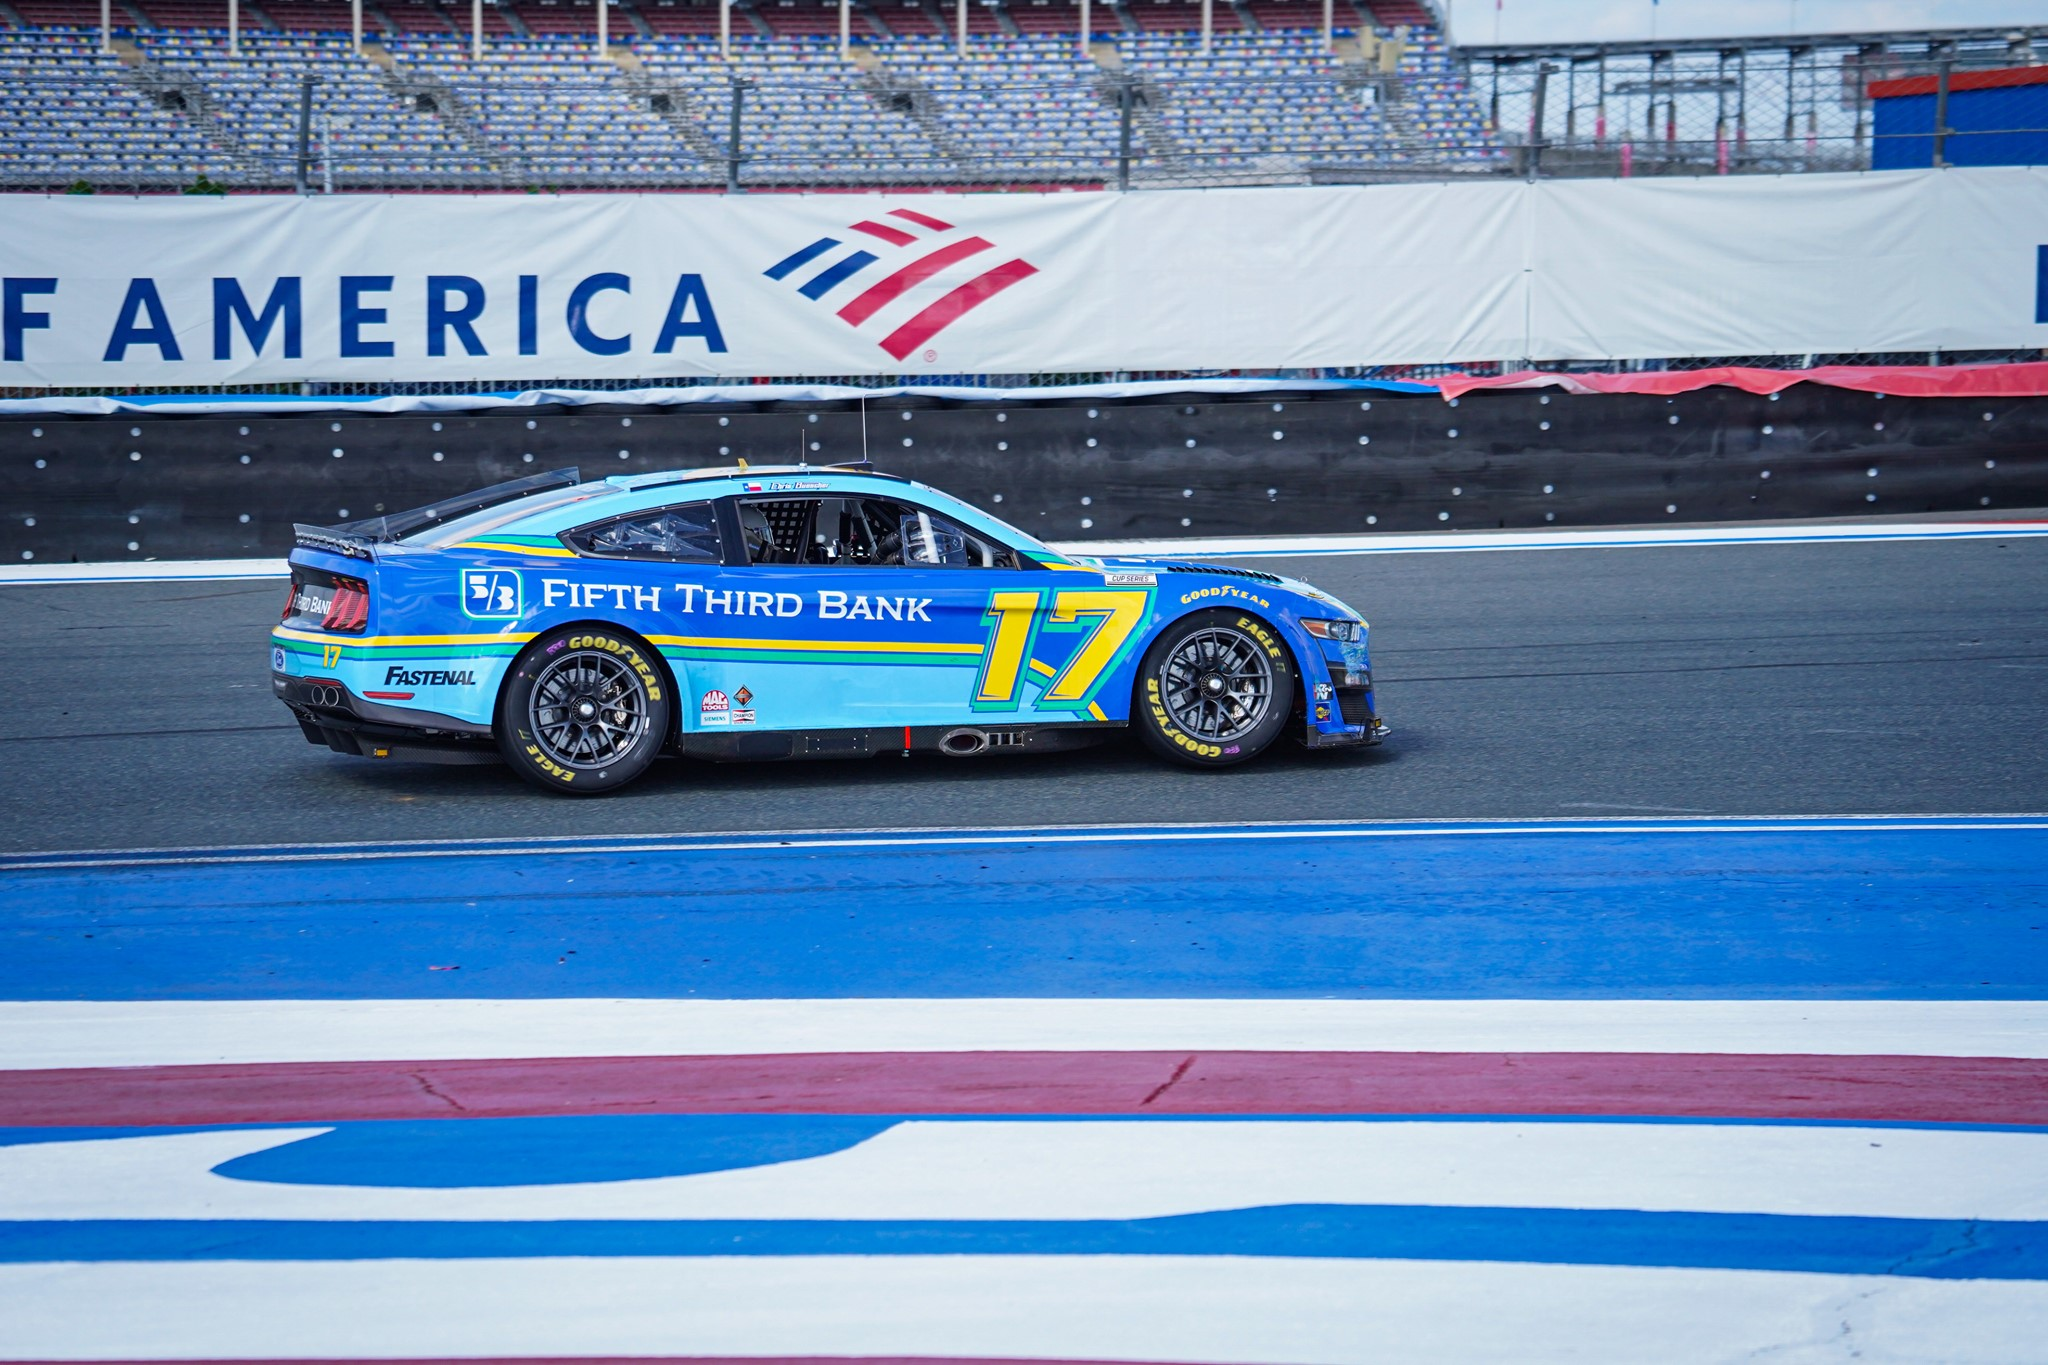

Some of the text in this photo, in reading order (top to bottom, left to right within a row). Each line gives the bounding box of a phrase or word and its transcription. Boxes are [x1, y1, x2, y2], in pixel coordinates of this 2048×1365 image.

[2, 272, 729, 362] F AMERICA
[541, 578, 933, 622] FIFTH THIRD BANK
[1180, 585, 1270, 609] GOODYEAR
[323, 645, 342, 669] 17
[969, 587, 1158, 713] 17
[1236, 617, 1282, 658] EAGLE
[384, 666, 476, 686] FASTENAL
[569, 635, 662, 701] GOODYEAR
[703, 691, 728, 704] MAC
[1147, 678, 1222, 758] GOODYEAR
[526, 744, 576, 782] EAGLE
